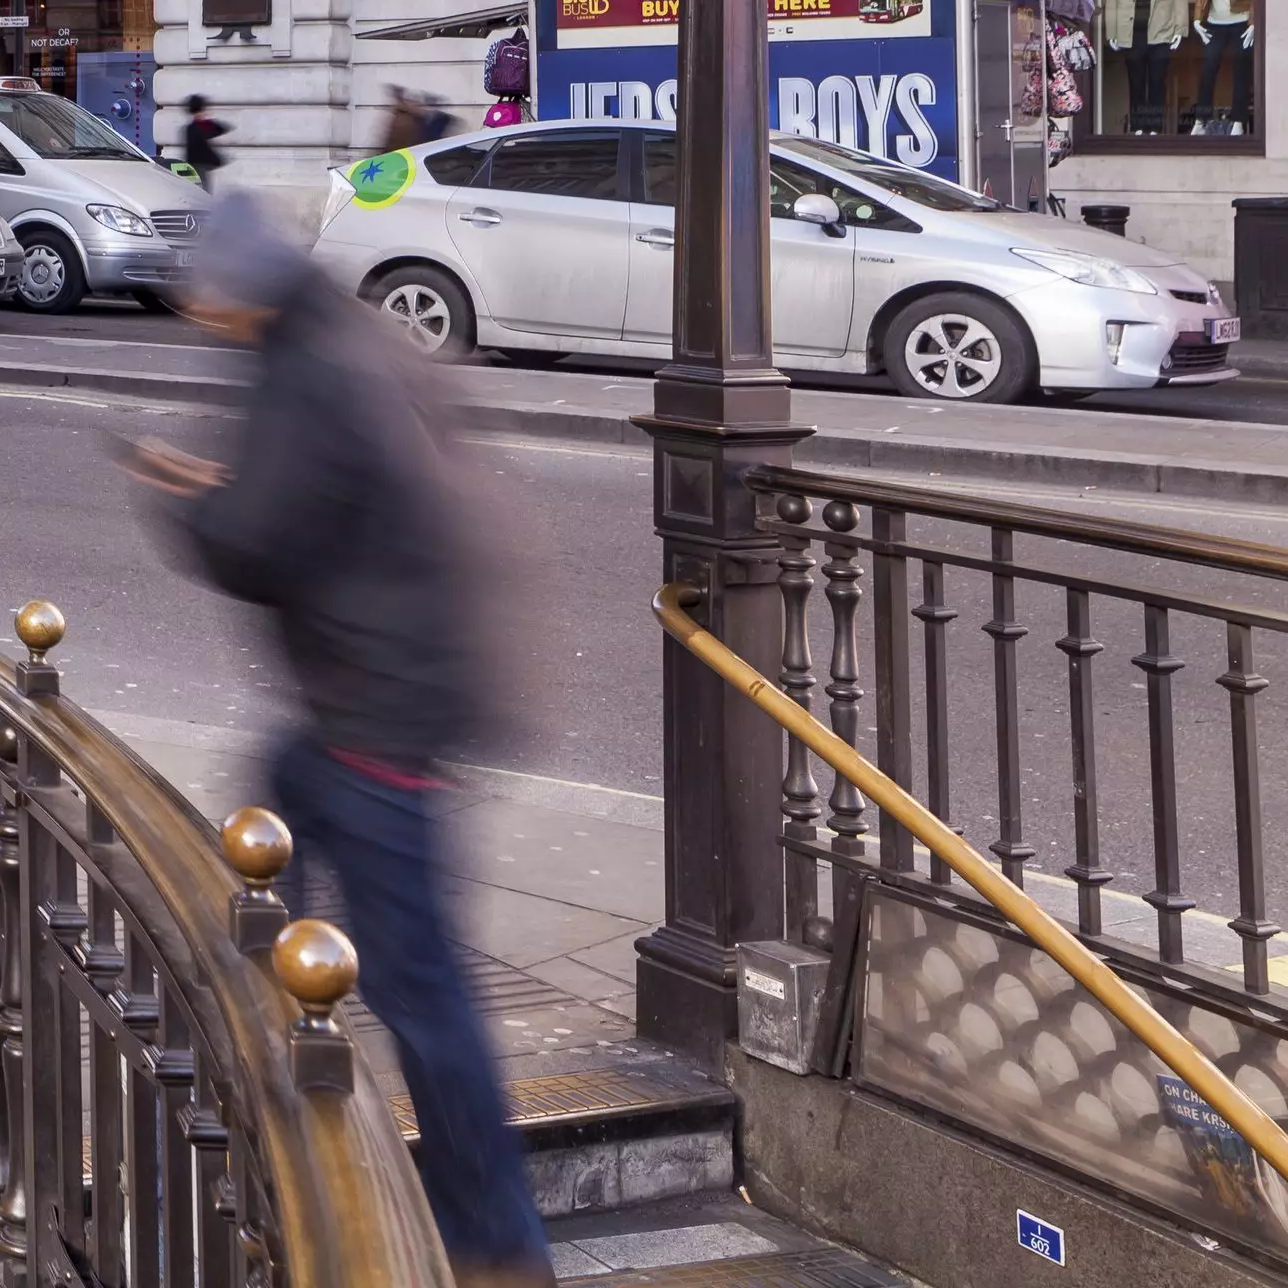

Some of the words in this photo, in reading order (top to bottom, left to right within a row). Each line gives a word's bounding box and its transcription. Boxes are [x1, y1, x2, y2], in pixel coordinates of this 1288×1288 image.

[563, 3, 589, 16] BUS
[642, 0, 680, 17] BUY
[58, 28, 70, 37] OR
[31, 39, 48, 48] NOT
[49, 38, 79, 47] DECAF?
[778, 73, 939, 168] BOYS
[1164, 1084, 1180, 1098] ON
[1030, 1237, 1051, 1256] 602
